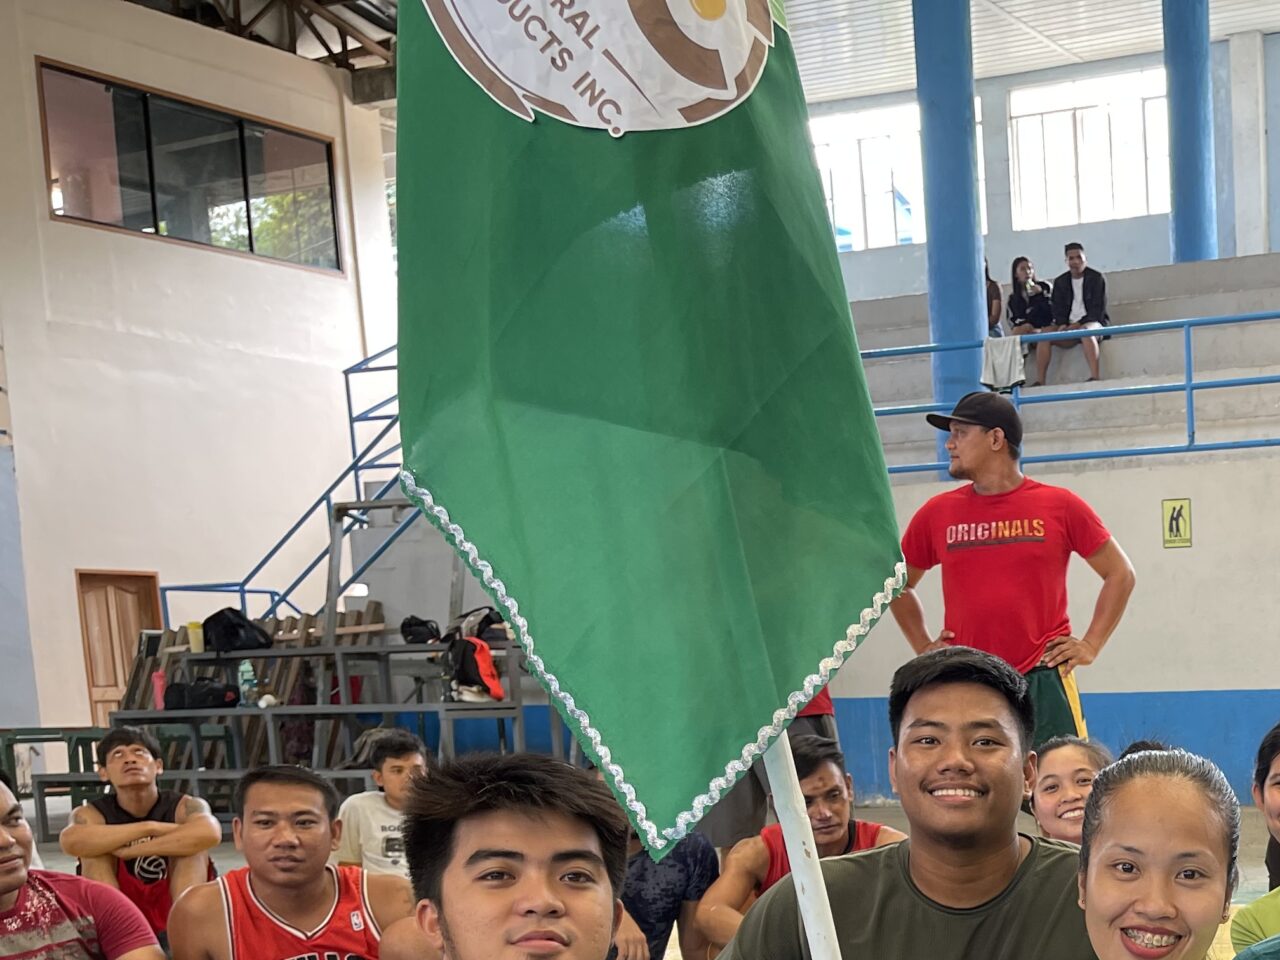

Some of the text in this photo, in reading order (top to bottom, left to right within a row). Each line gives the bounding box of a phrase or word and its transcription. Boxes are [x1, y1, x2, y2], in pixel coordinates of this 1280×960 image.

[497, 0, 622, 135] UCTS INC.
[946, 519, 1045, 544] ORIGINALS
